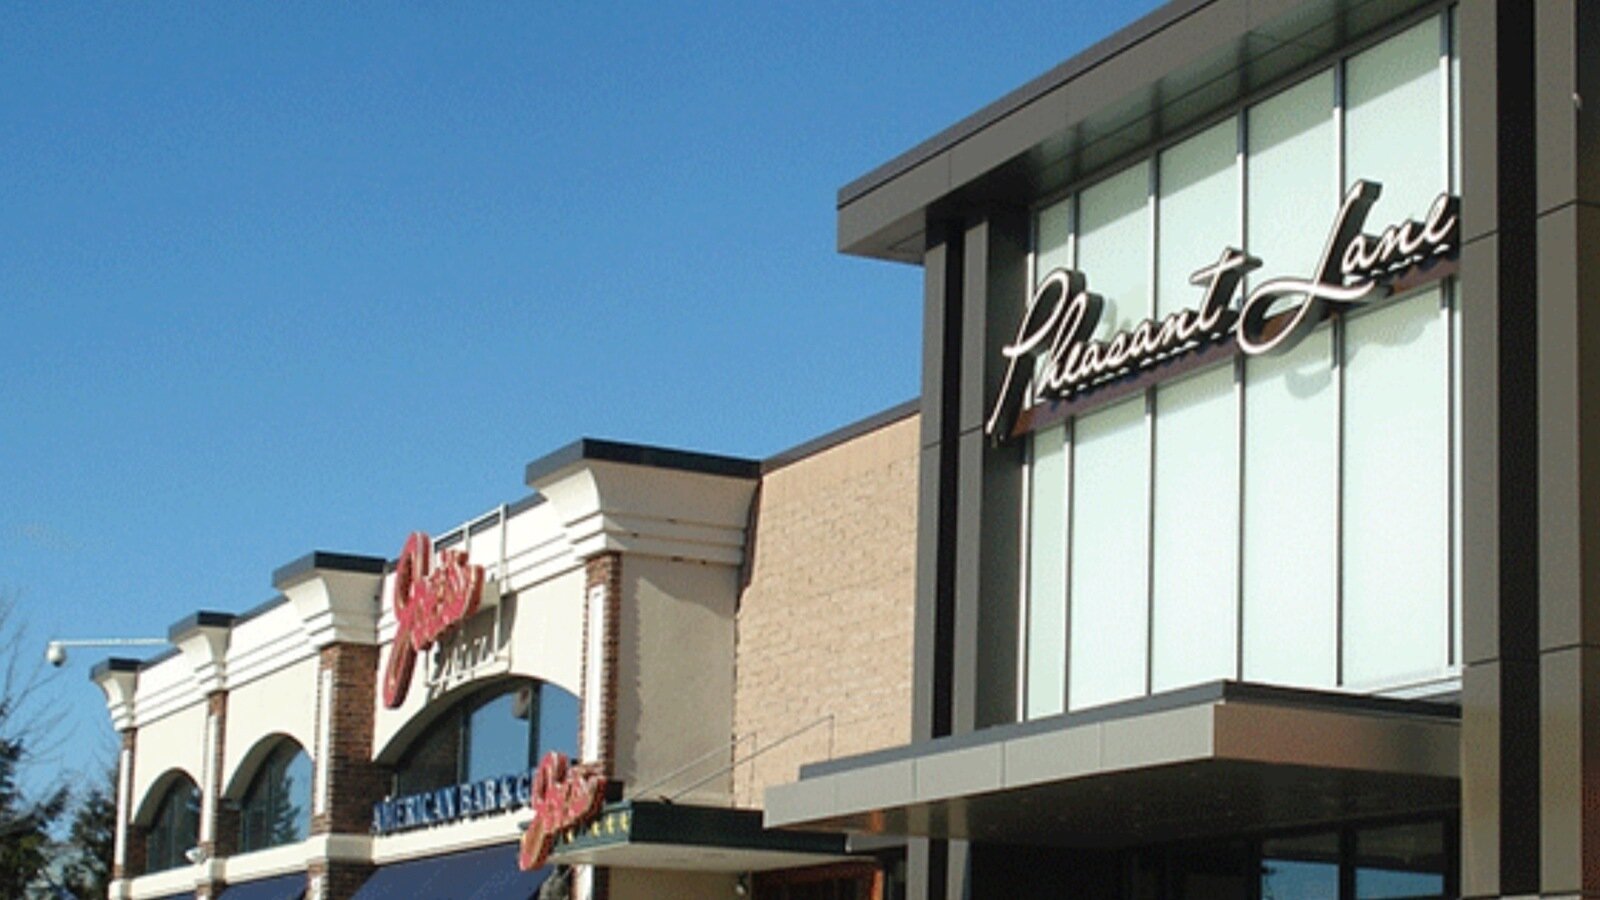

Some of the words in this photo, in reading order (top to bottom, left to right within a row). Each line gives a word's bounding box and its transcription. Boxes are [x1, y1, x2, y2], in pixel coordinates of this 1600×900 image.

[985, 248, 1258, 437] Pheasant
[1236, 179, 1460, 355] Lane
[460, 778, 495, 816] BAR
